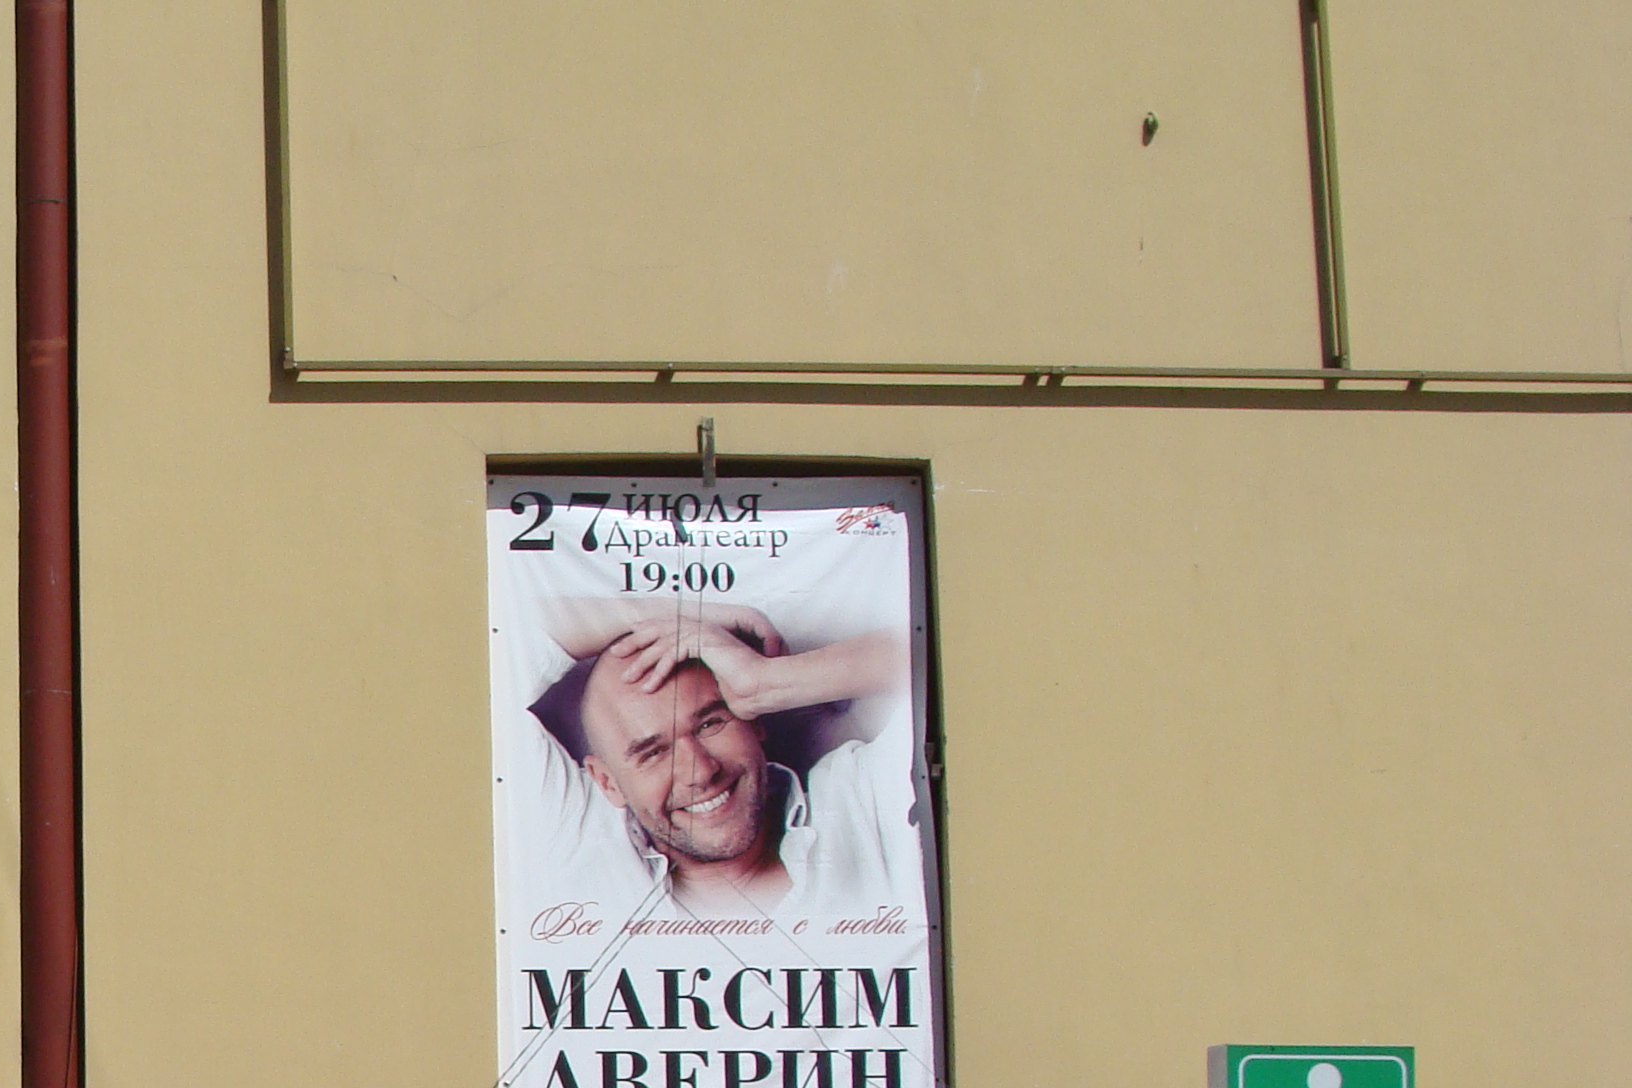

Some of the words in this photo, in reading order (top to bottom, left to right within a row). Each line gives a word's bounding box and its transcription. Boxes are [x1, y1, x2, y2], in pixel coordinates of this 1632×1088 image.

[508, 490, 612, 553] 27
[621, 491, 764, 524] ИЮЛЯ
[604, 521, 789, 559] Драмтеатр
[618, 560, 736, 594] 19:00
[530, 900, 603, 945] Все
[620, 917, 774, 938] начинается
[792, 918, 809, 936] с
[520, 966, 920, 1032] МАКСИМ
